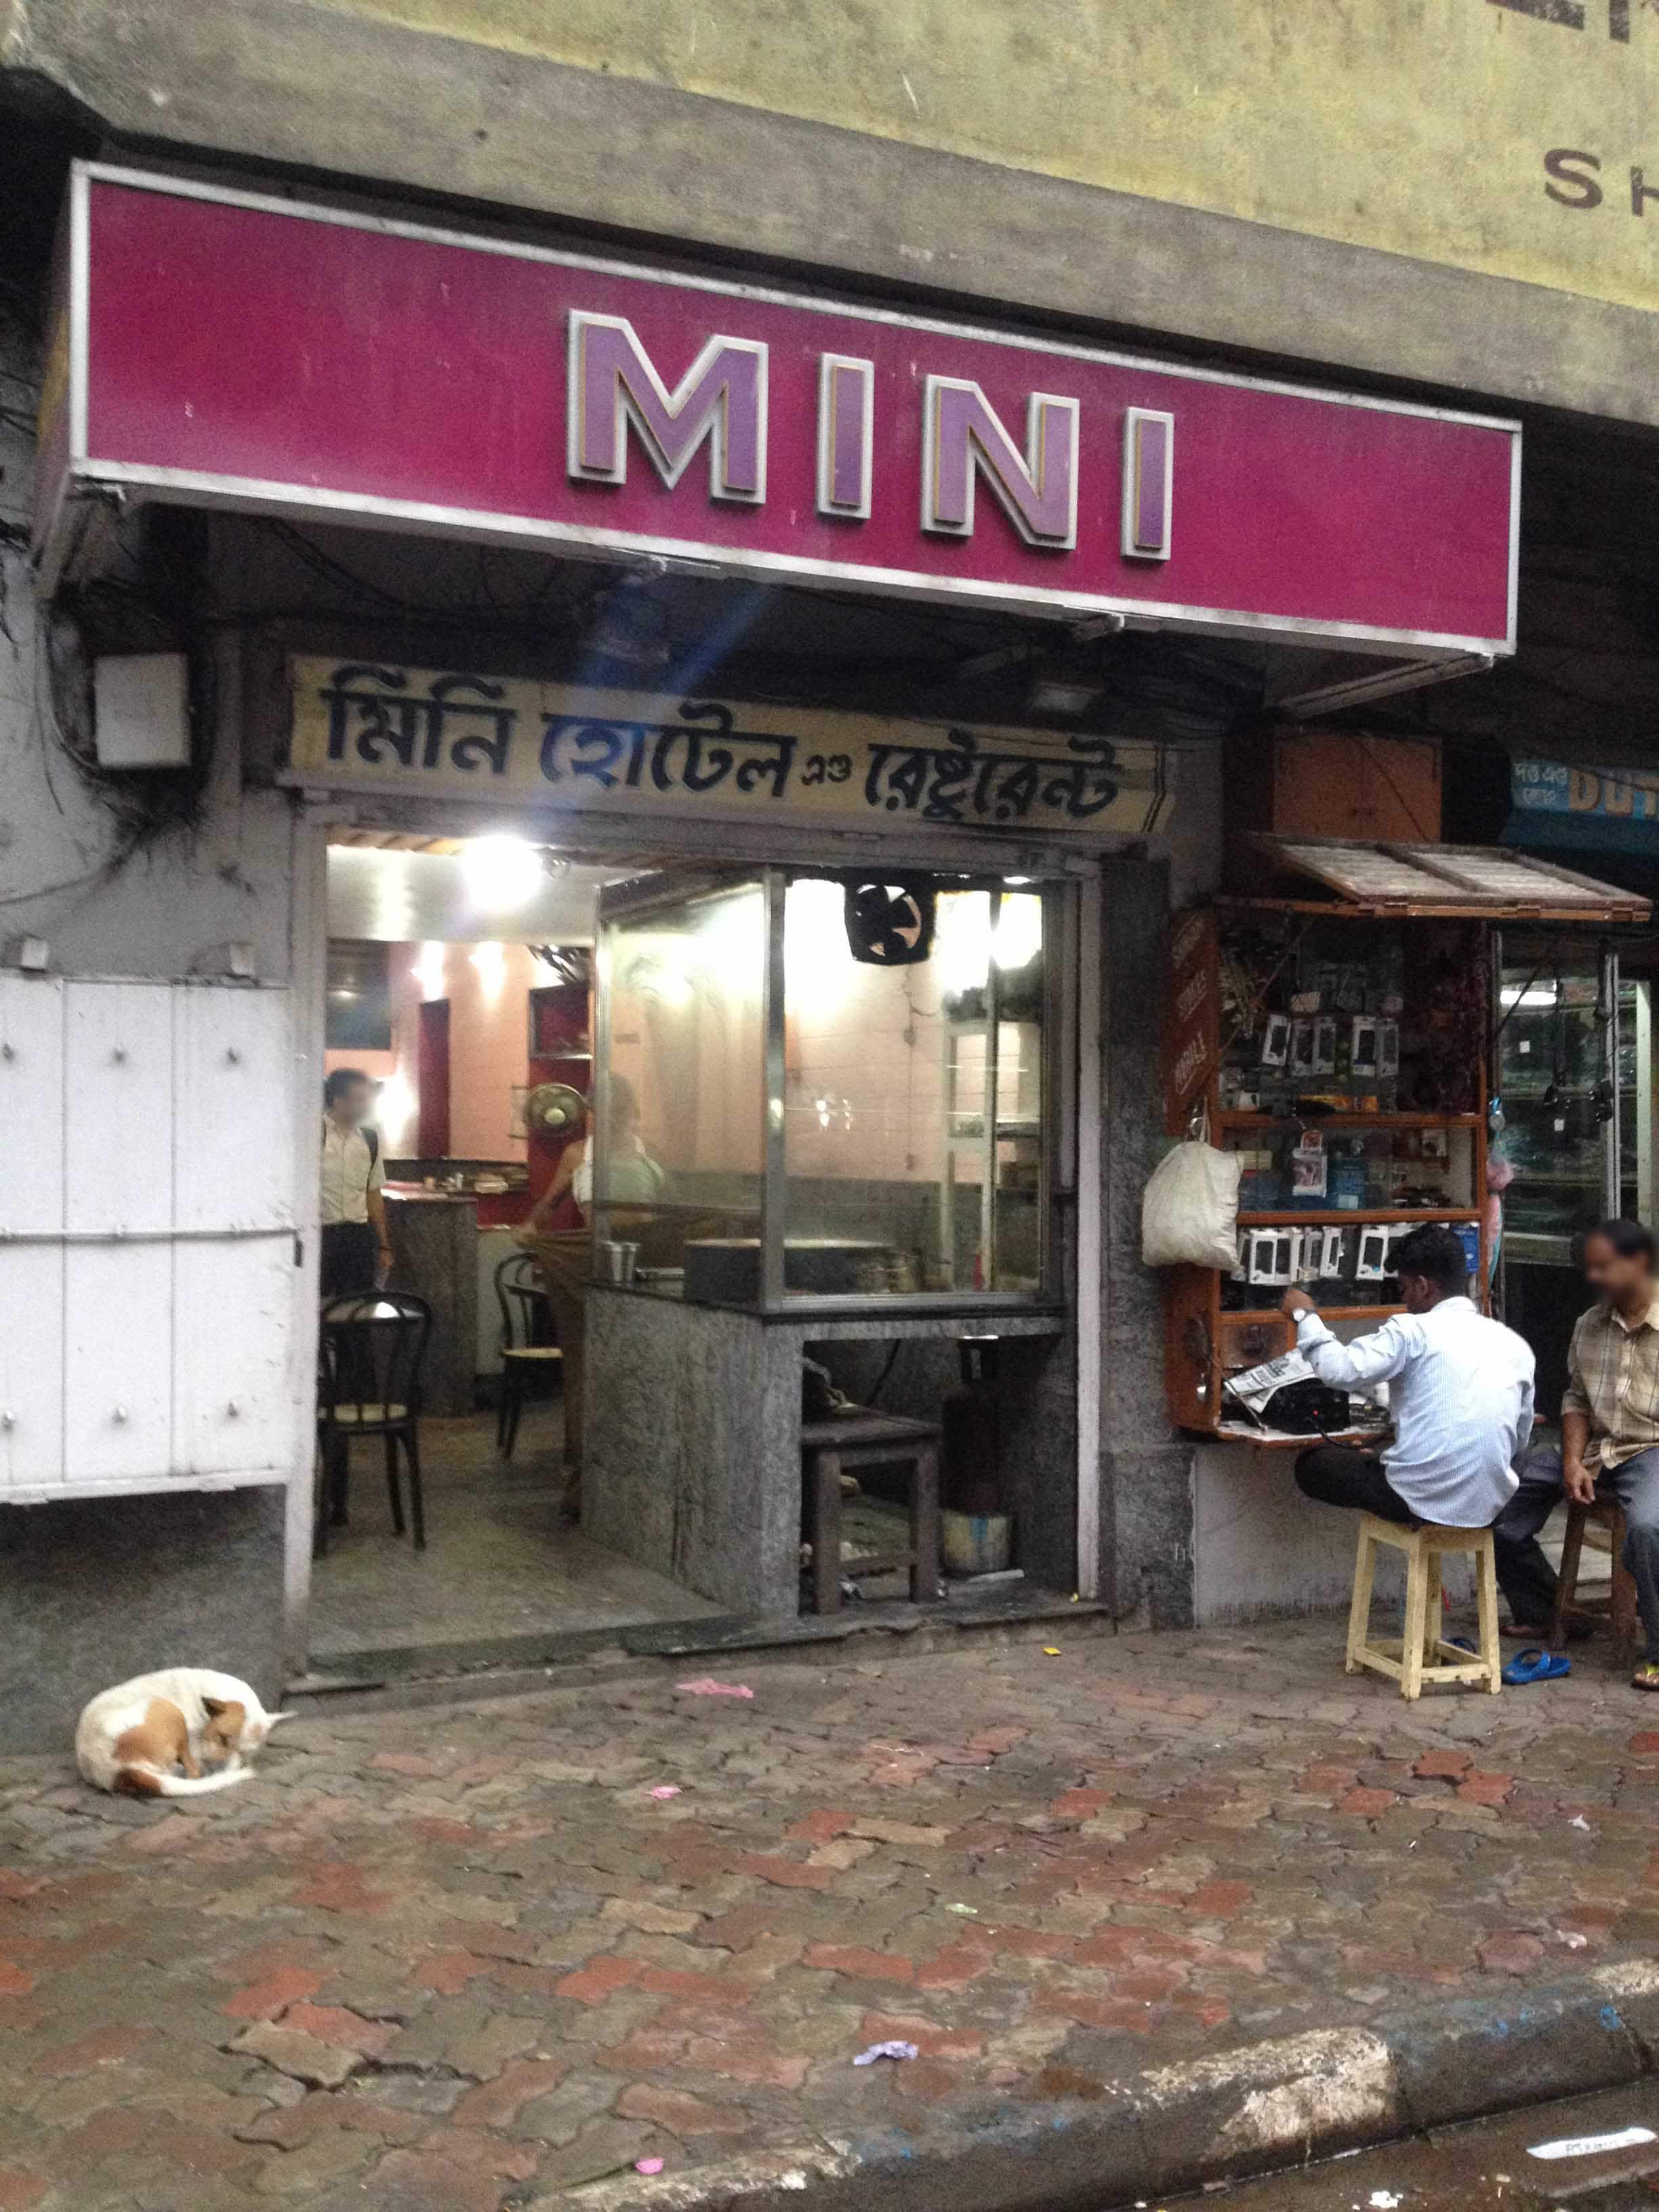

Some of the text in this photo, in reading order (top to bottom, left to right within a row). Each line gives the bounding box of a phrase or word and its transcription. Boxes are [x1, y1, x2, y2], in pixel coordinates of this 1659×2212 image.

[567, 309, 1174, 560] MINI
[319, 665, 517, 774] মিনি
[541, 703, 798, 798] হোটেল
